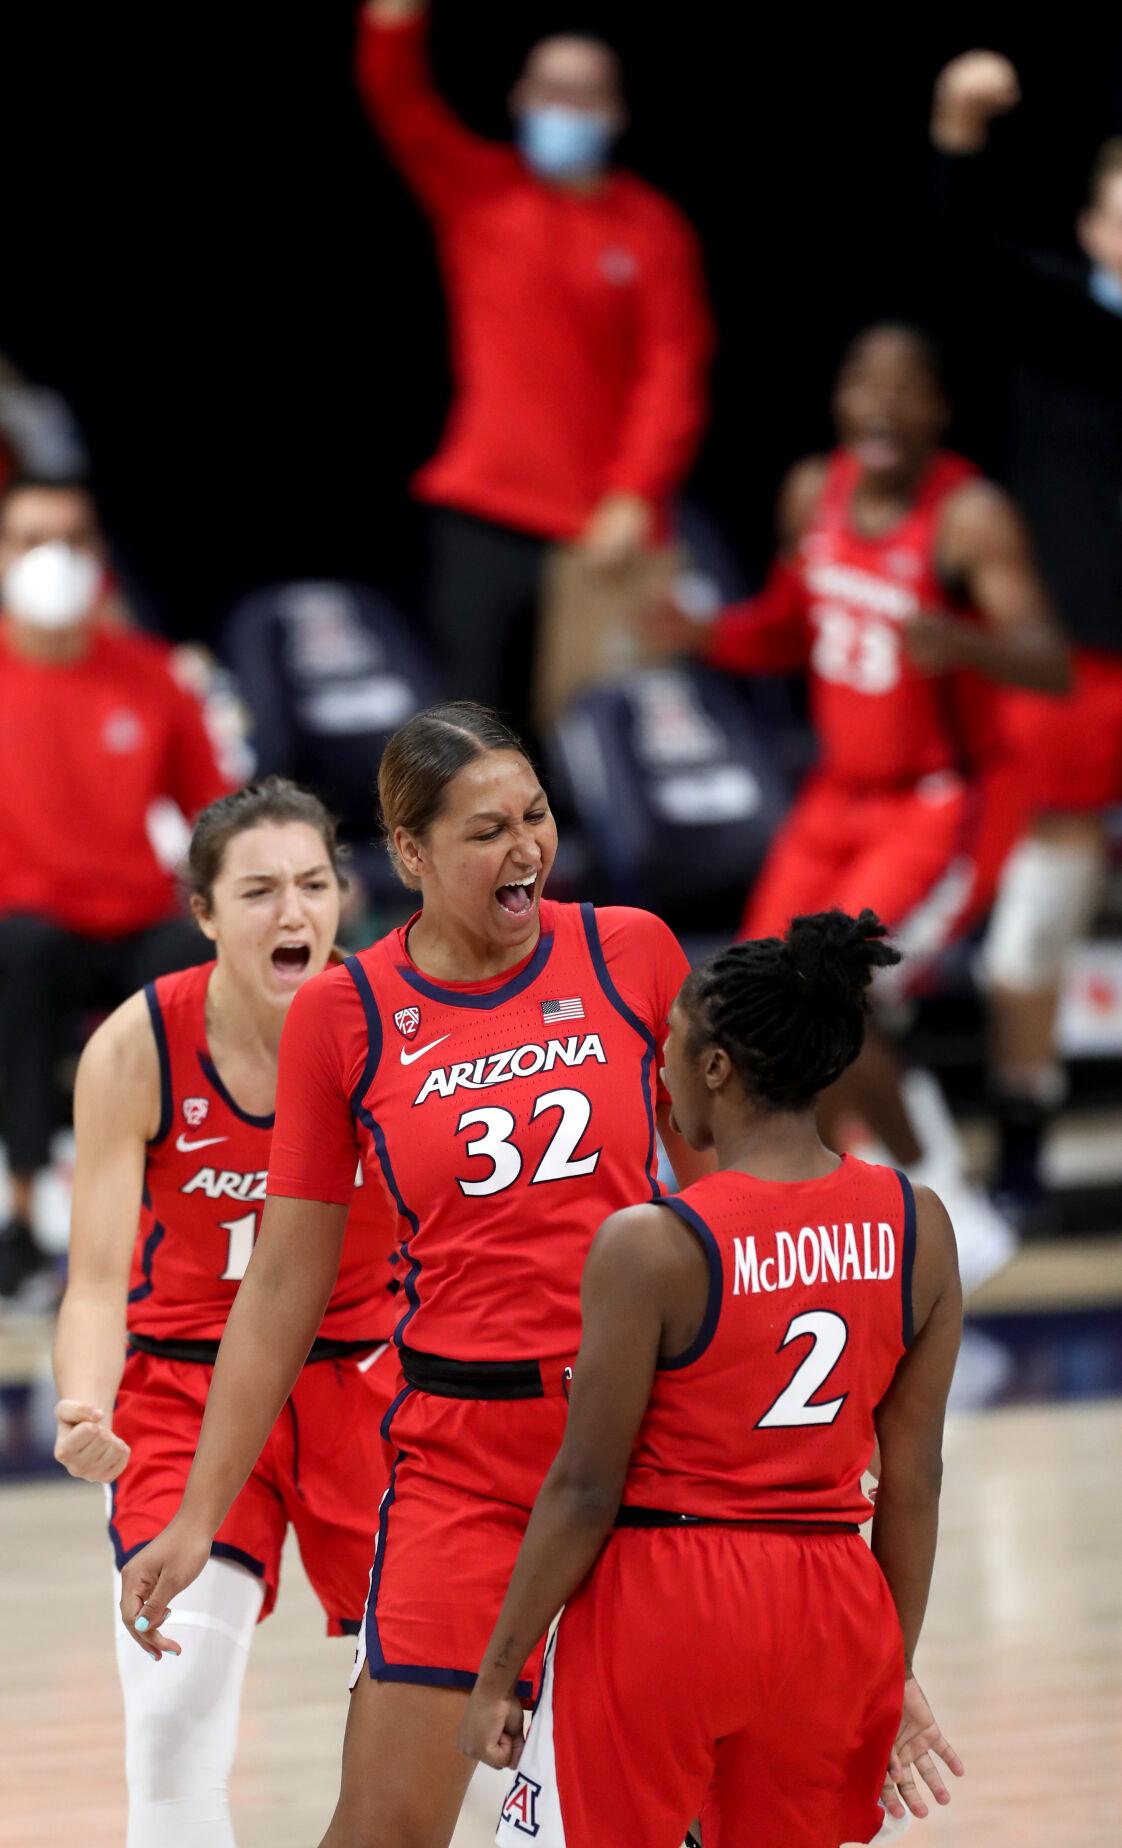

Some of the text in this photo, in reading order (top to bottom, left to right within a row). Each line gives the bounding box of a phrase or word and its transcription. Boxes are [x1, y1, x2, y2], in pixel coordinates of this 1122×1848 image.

[411, 1033, 608, 1108] ARIZONA
[454, 1087, 603, 1197] 32
[181, 1166, 268, 1202] ARIZ
[219, 1210, 258, 1281] 1
[733, 1222, 895, 1295] McDONALD
[753, 1309, 849, 1430] 2
[501, 1771, 541, 1838] A
